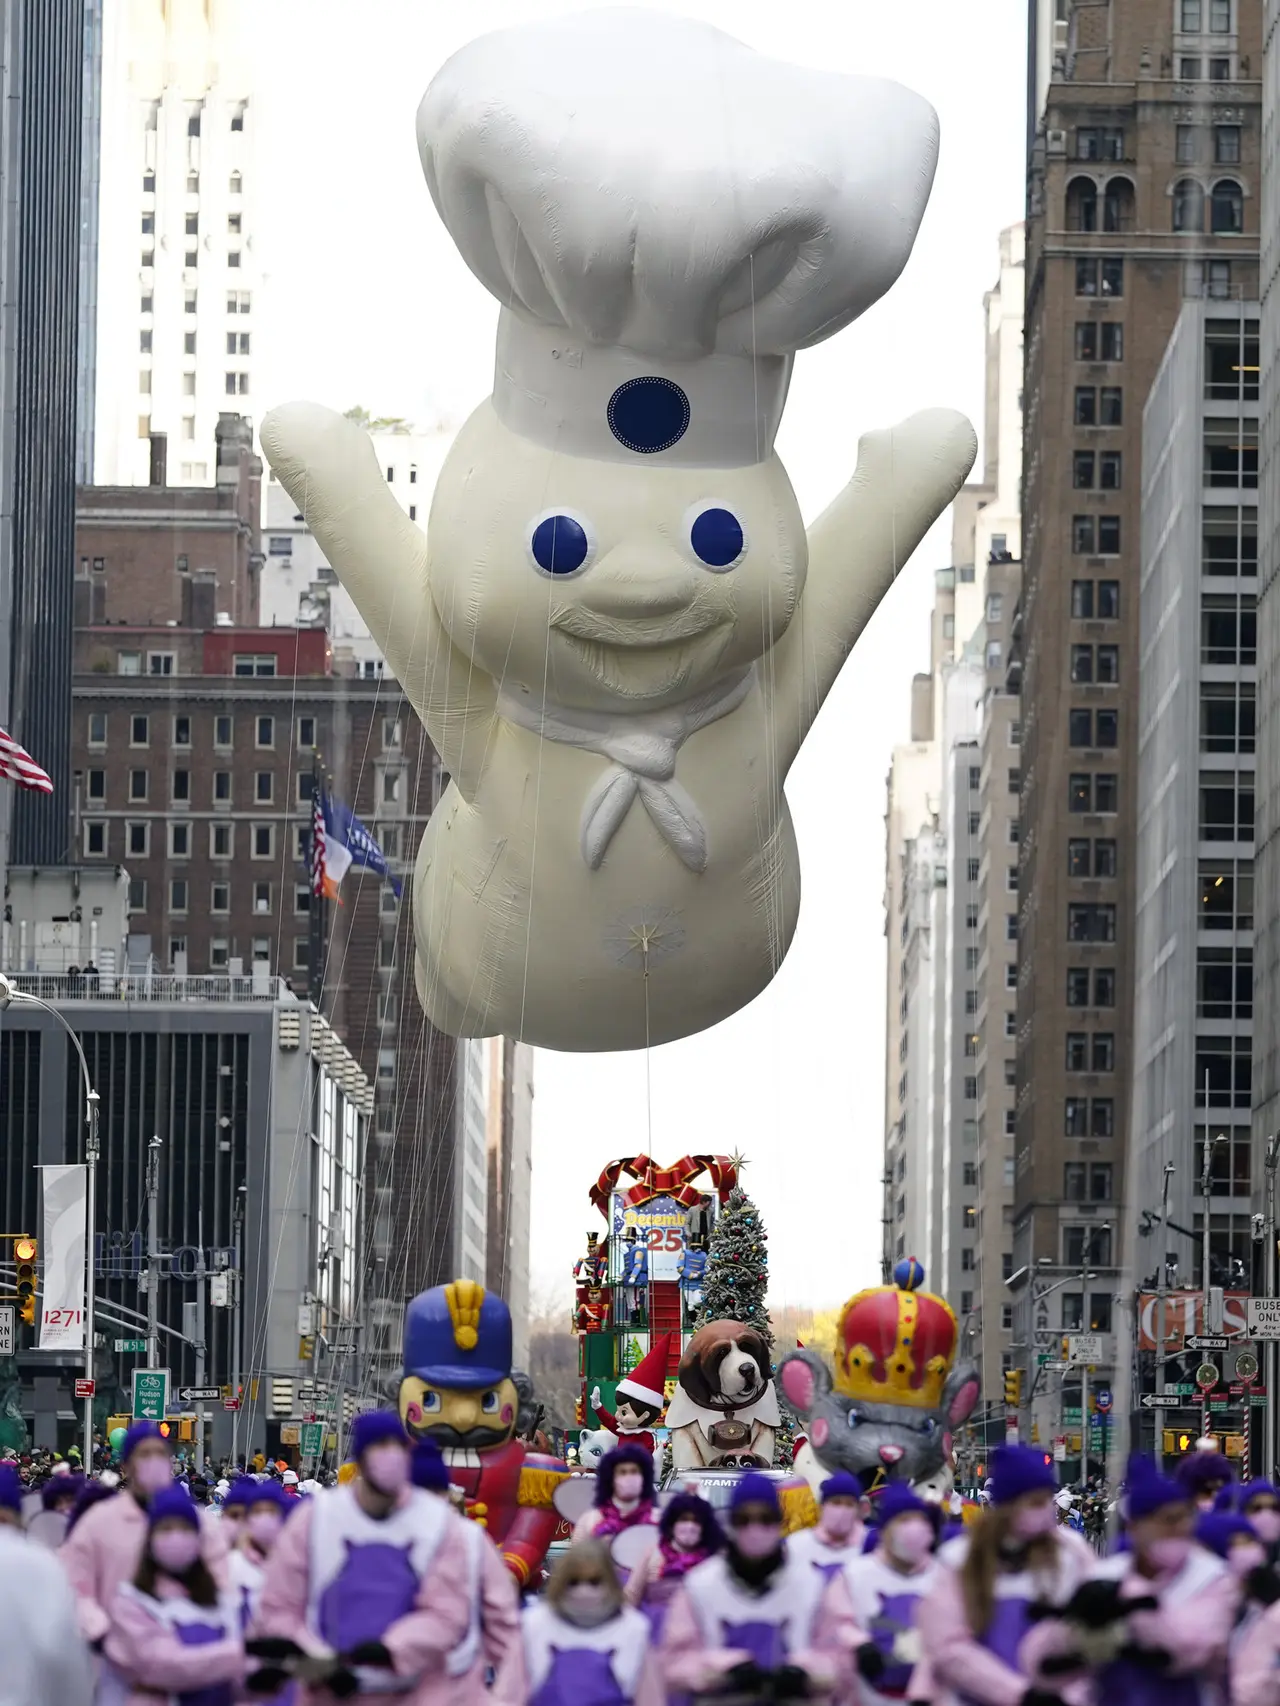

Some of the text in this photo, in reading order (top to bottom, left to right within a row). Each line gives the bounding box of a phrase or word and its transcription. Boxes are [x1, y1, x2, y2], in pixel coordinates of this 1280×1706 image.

[624, 1212, 687, 1225] Decemb
[647, 1229, 683, 1252] 25
[45, 1310, 81, 1327] 1271
[132, 1341, 138, 1351] 51
[139, 1390, 161, 1398] Hudson
